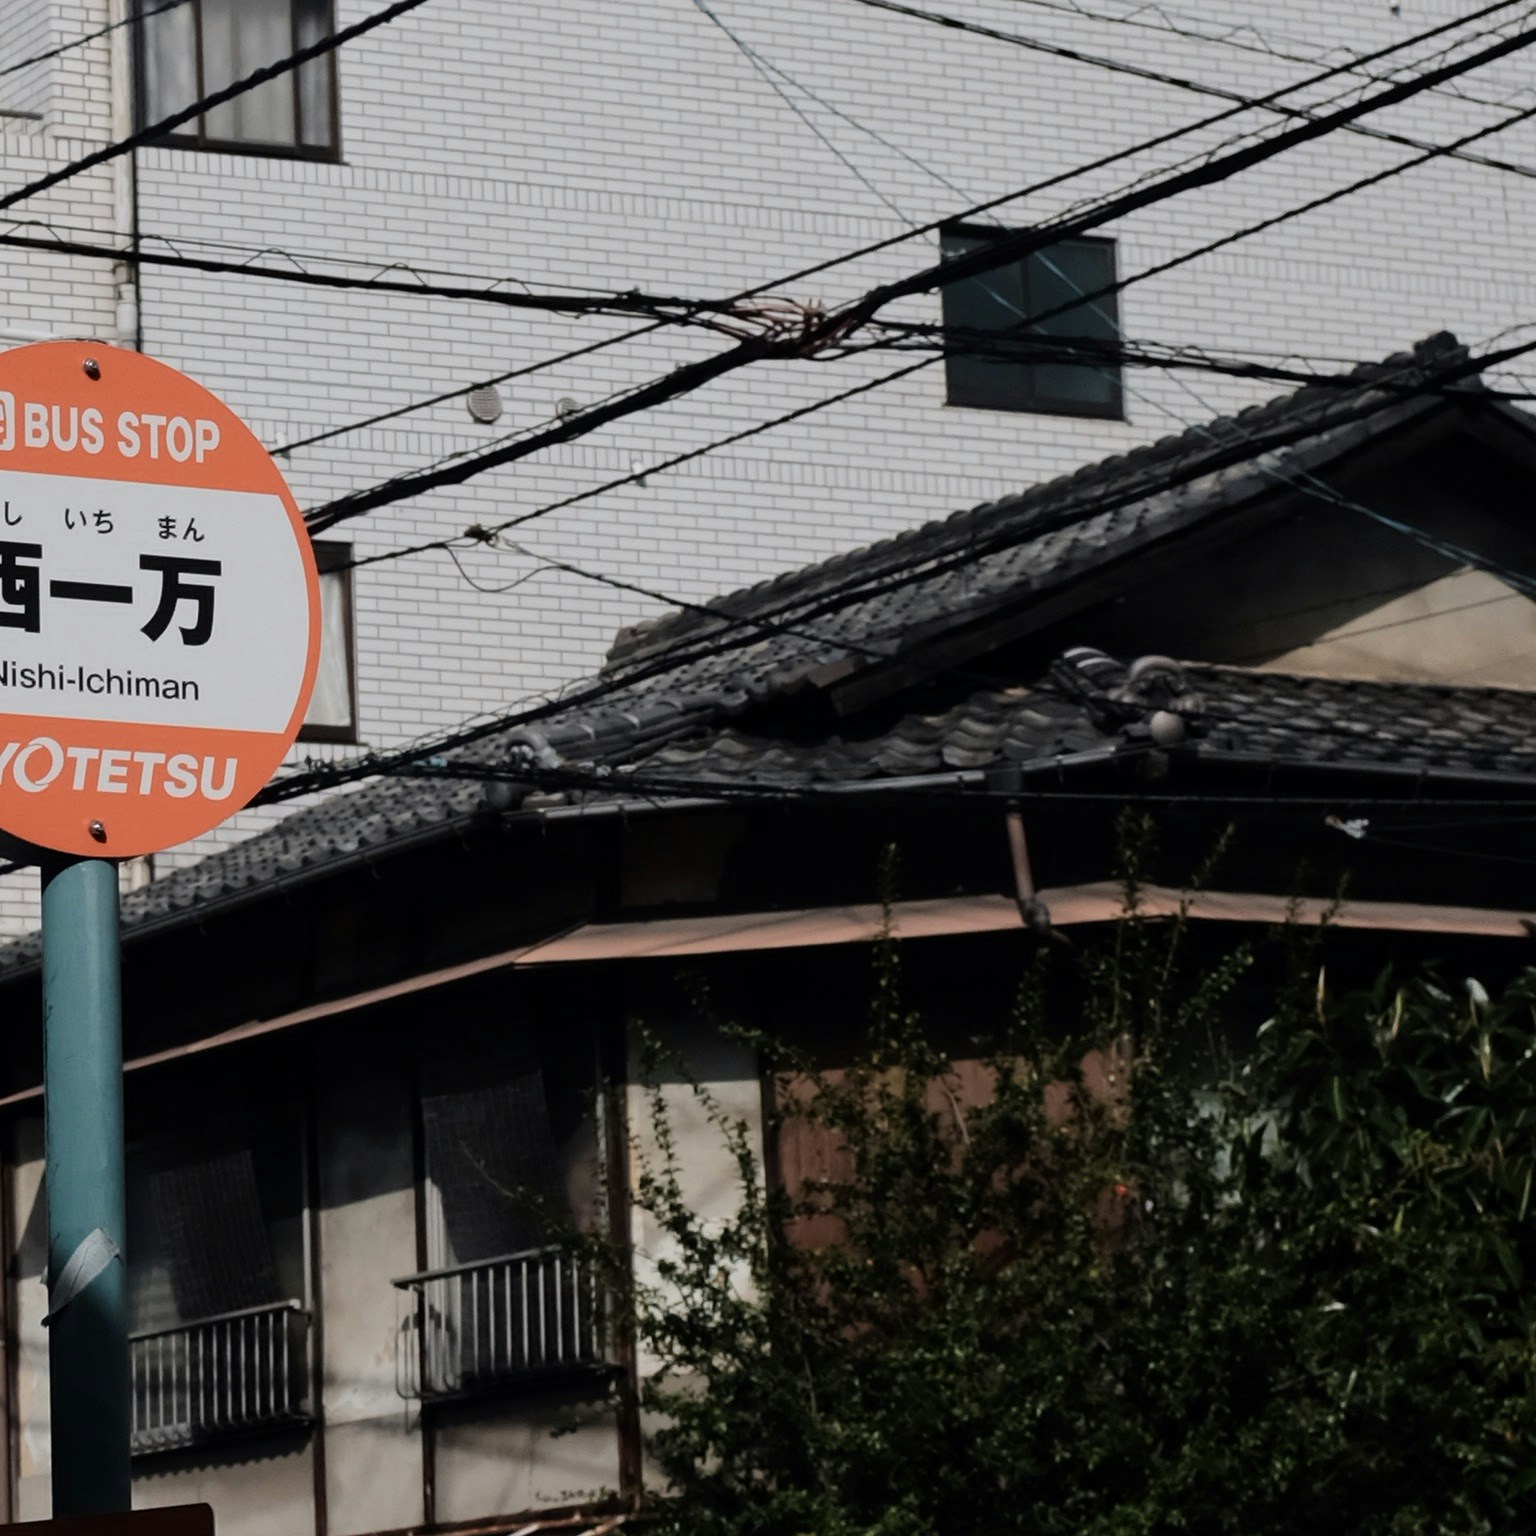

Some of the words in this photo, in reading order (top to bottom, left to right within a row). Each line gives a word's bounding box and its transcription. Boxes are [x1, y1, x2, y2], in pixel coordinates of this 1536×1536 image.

[24, 403, 104, 455] BUS
[117, 410, 220, 463] STOP
[64, 507, 114, 535] いち
[157, 515, 206, 543] まん
